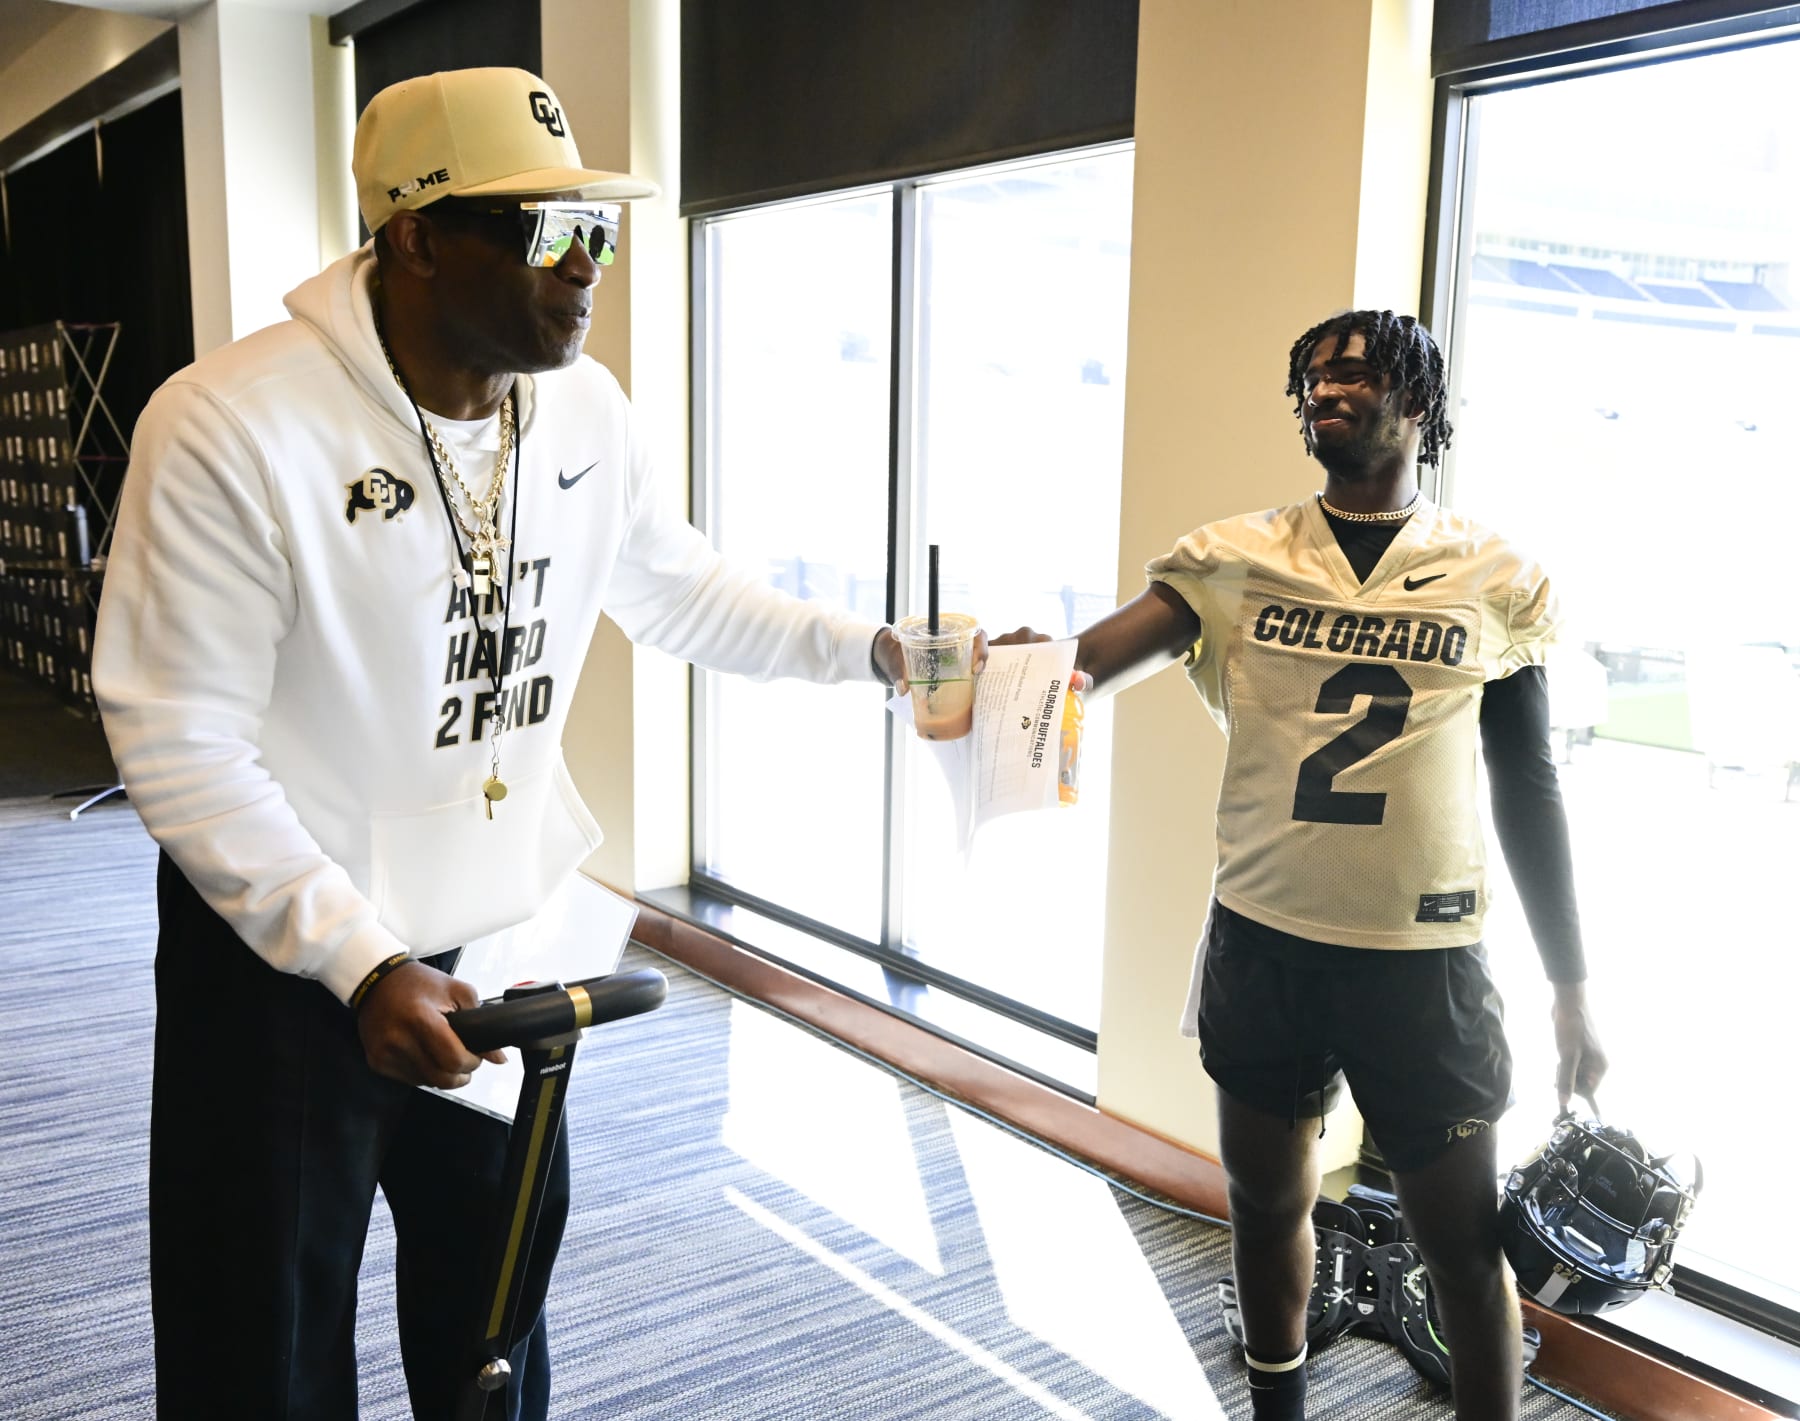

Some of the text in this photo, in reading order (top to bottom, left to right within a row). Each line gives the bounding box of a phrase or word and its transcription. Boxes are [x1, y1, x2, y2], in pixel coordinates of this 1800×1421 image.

[529, 91, 565, 138] CU
[387, 168, 450, 203] PME
[363, 472, 397, 510] CU
[444, 618, 547, 686] HARD
[1253, 604, 1467, 666] COLORADO
[434, 697, 461, 750] 2
[1031, 680, 1061, 768] COLORADO BUFFALOES
[1292, 662, 1413, 825] 2
